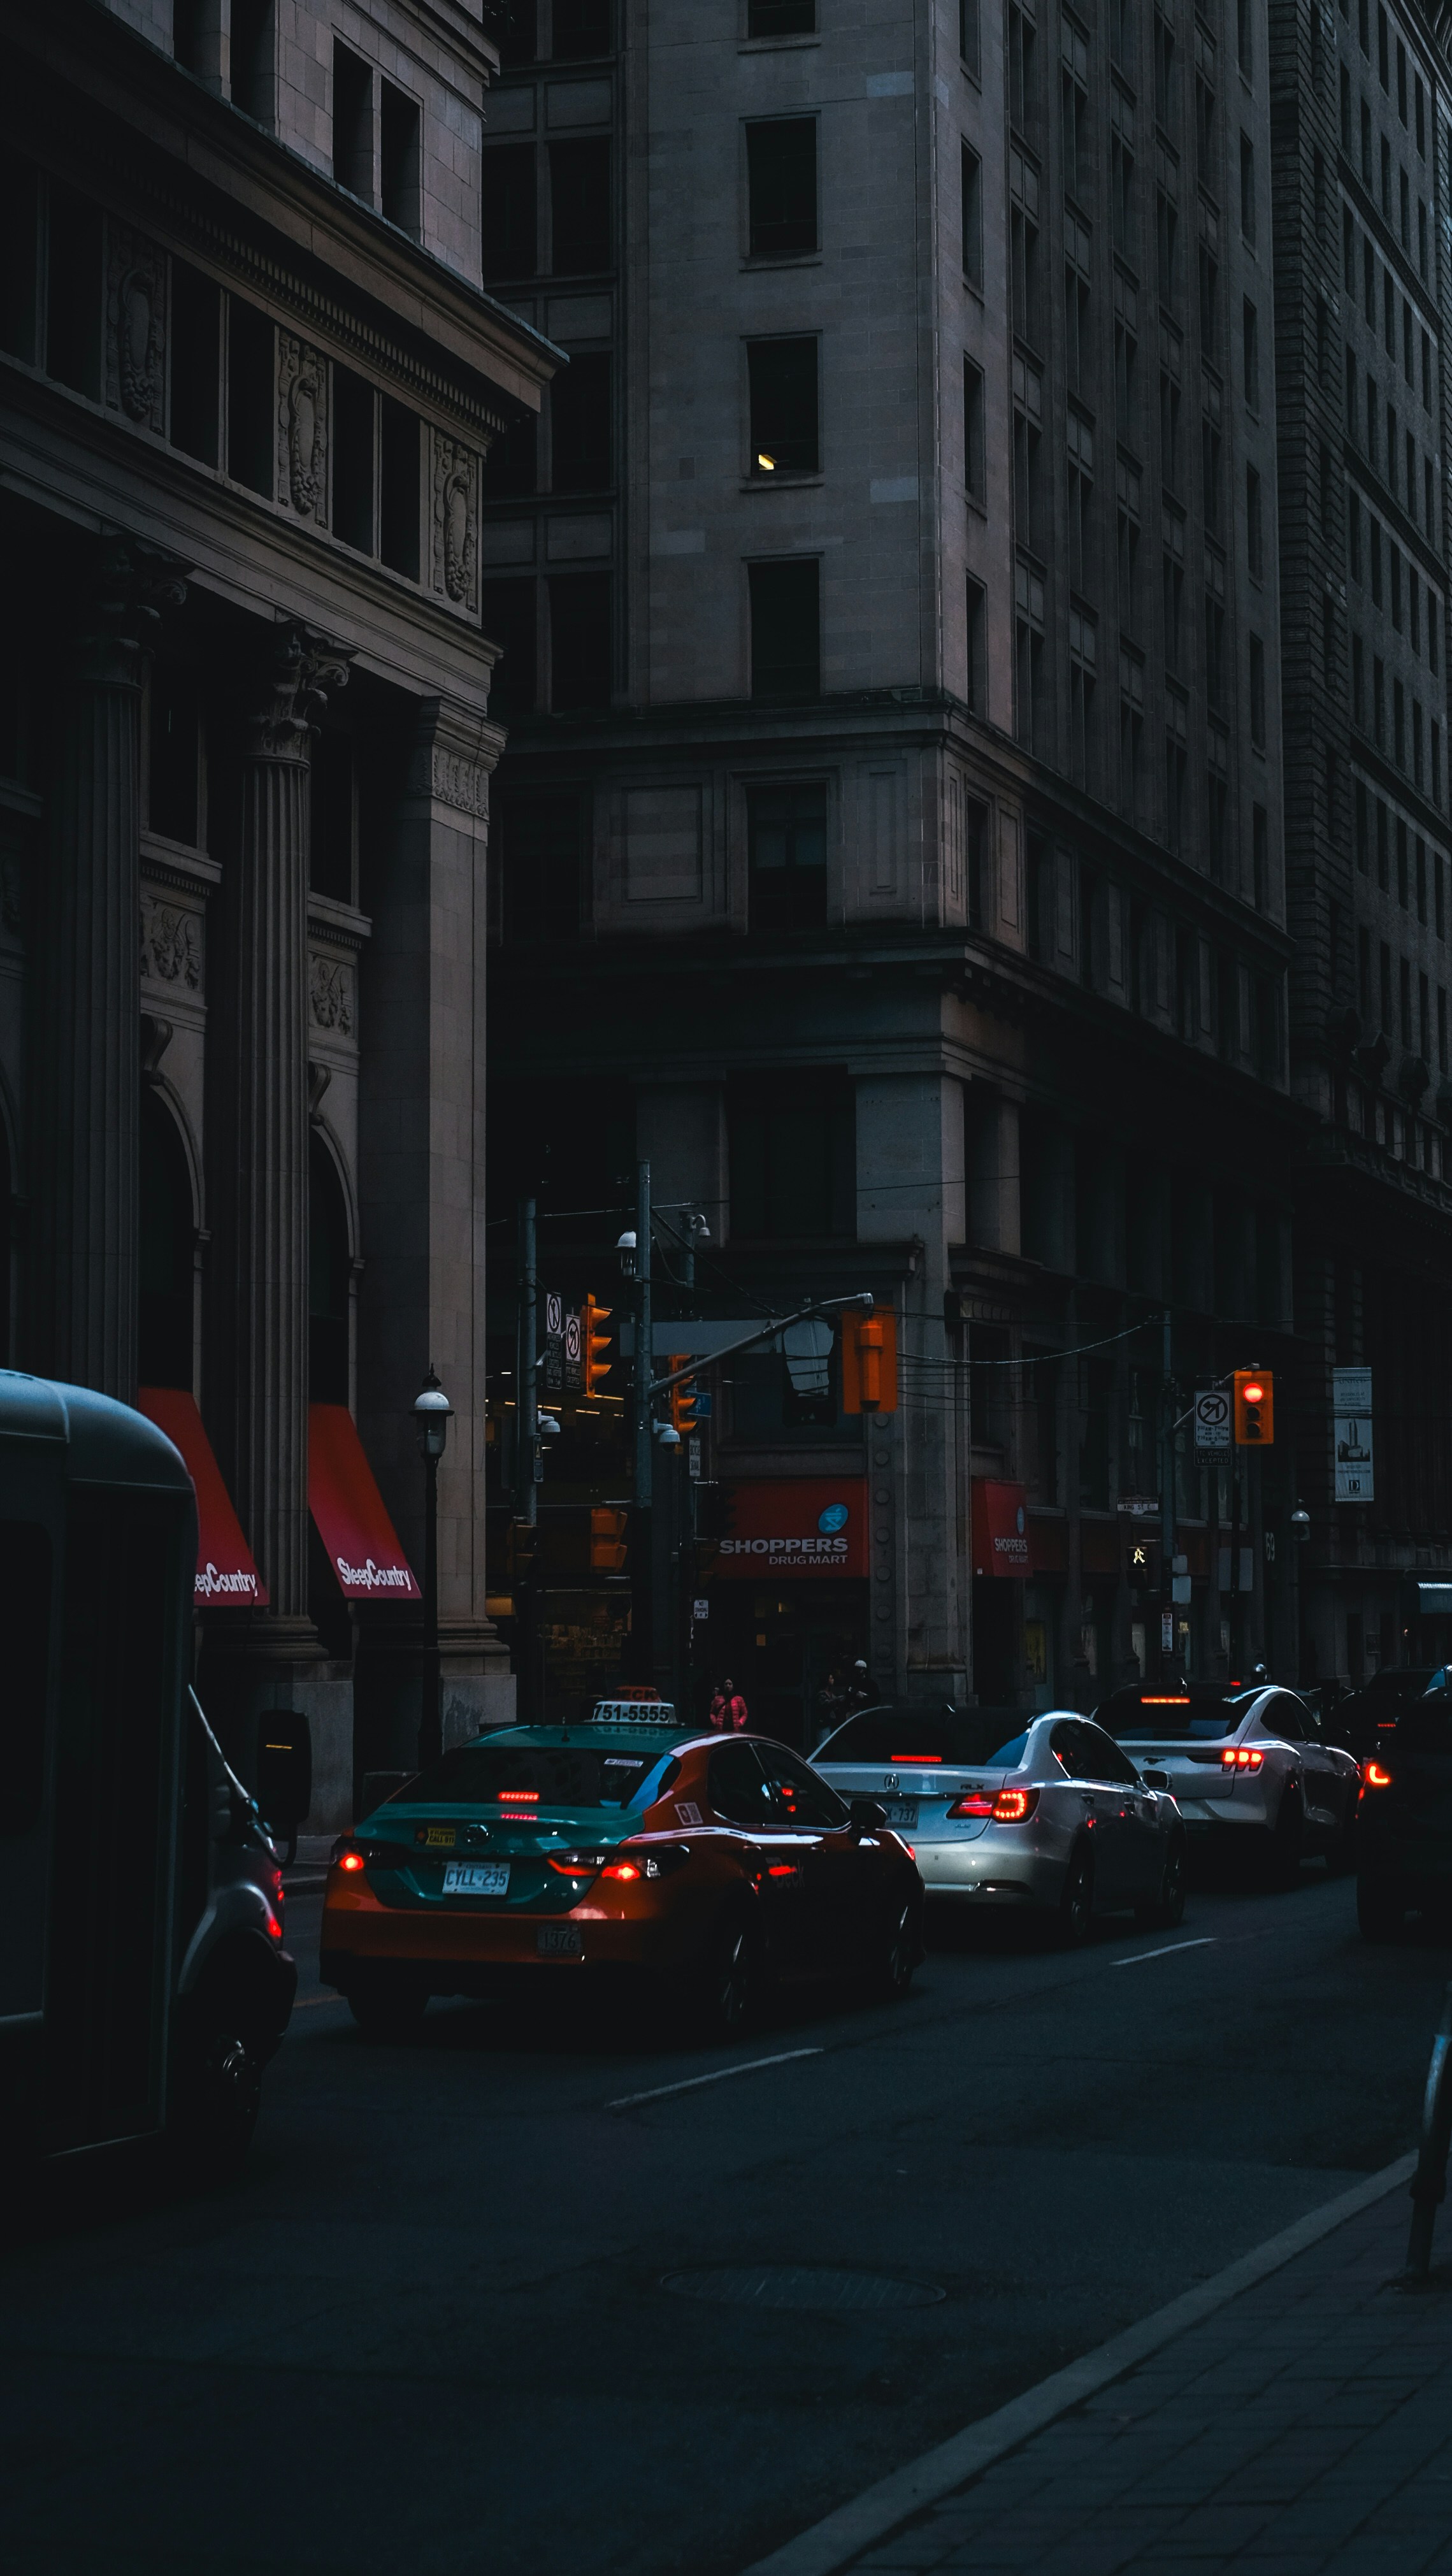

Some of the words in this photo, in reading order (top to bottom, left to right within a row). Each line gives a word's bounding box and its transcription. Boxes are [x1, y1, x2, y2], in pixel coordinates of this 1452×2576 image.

[719, 1538, 848, 1554] SHOPPERS
[995, 1537, 1028, 1553] SHOPPERS
[769, 1555, 807, 1565] DRUG
[809, 1555, 848, 1564] MART
[194, 1562, 258, 1597] epCountry
[336, 1557, 412, 1591] SleepCountry
[592, 1704, 670, 1721] 751-5555
[898, 1808, 916, 1821] 737
[482, 1870, 507, 1887] 235
[544, 1932, 576, 1948] 1376
